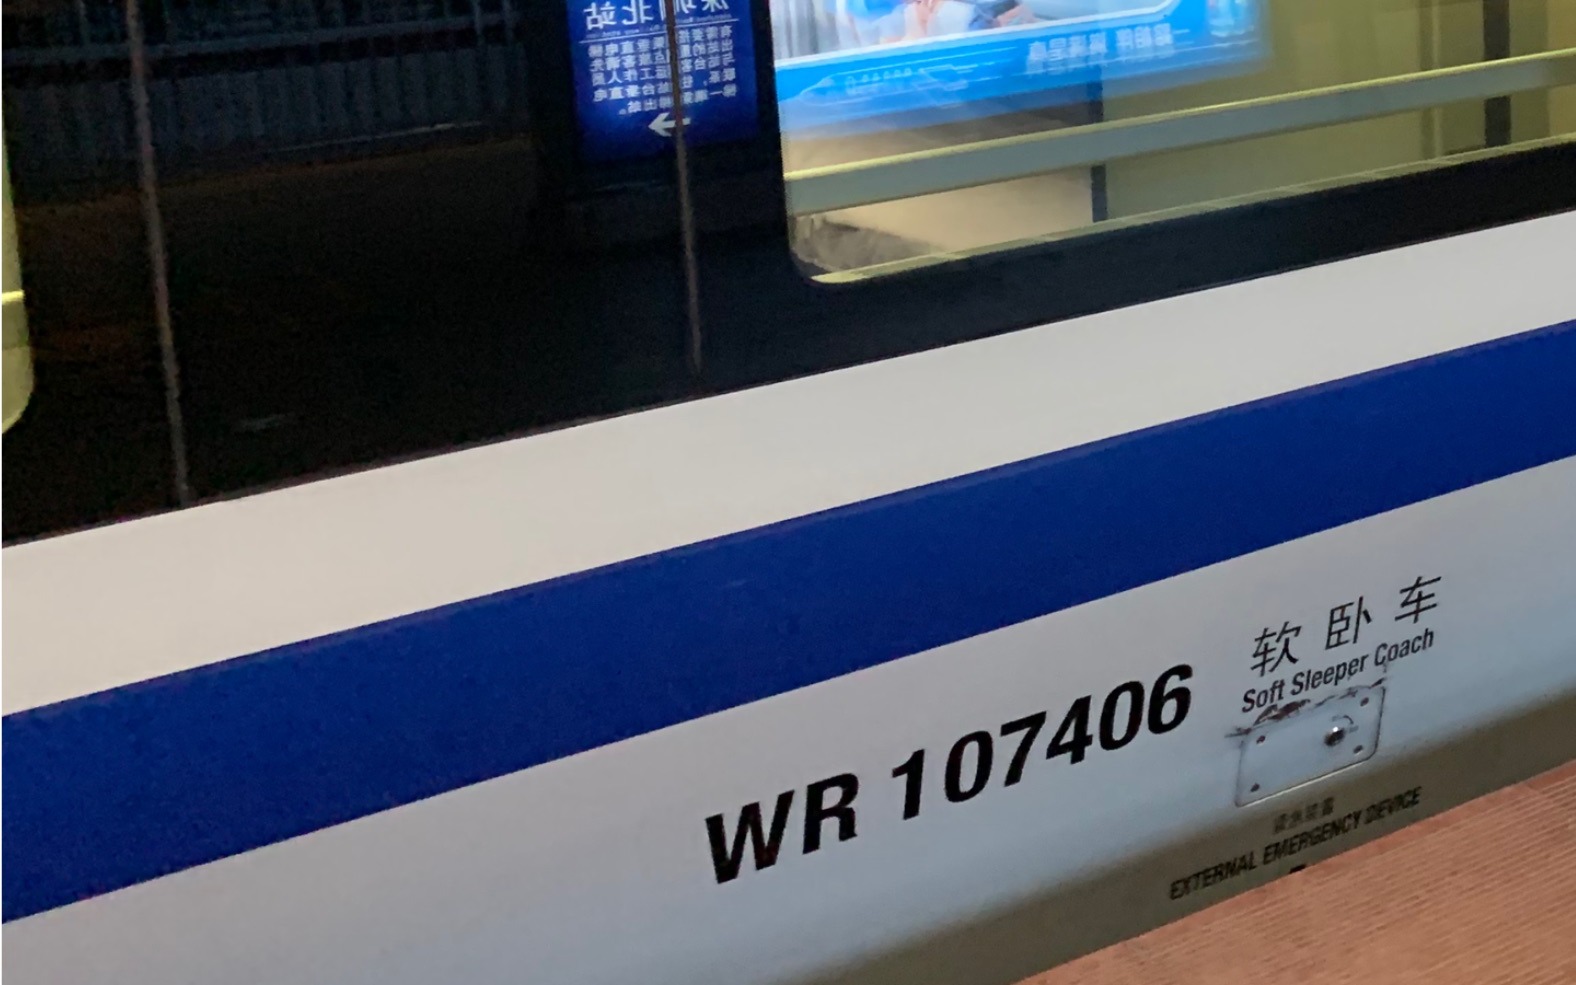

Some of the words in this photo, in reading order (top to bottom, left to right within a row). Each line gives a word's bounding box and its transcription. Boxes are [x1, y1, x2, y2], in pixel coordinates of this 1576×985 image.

[1241, 679, 1285, 713] Soft
[1290, 653, 1369, 696] Sleeper
[1374, 627, 1435, 666] Coach
[1250, 576, 1442, 677] 软卧车
[705, 772, 859, 884] WR
[892, 663, 1193, 820] 107406
[1169, 851, 1257, 900] EXTERNAL
[1262, 809, 1363, 865] EMERGENCY
[1365, 785, 1422, 824] DEVICE
